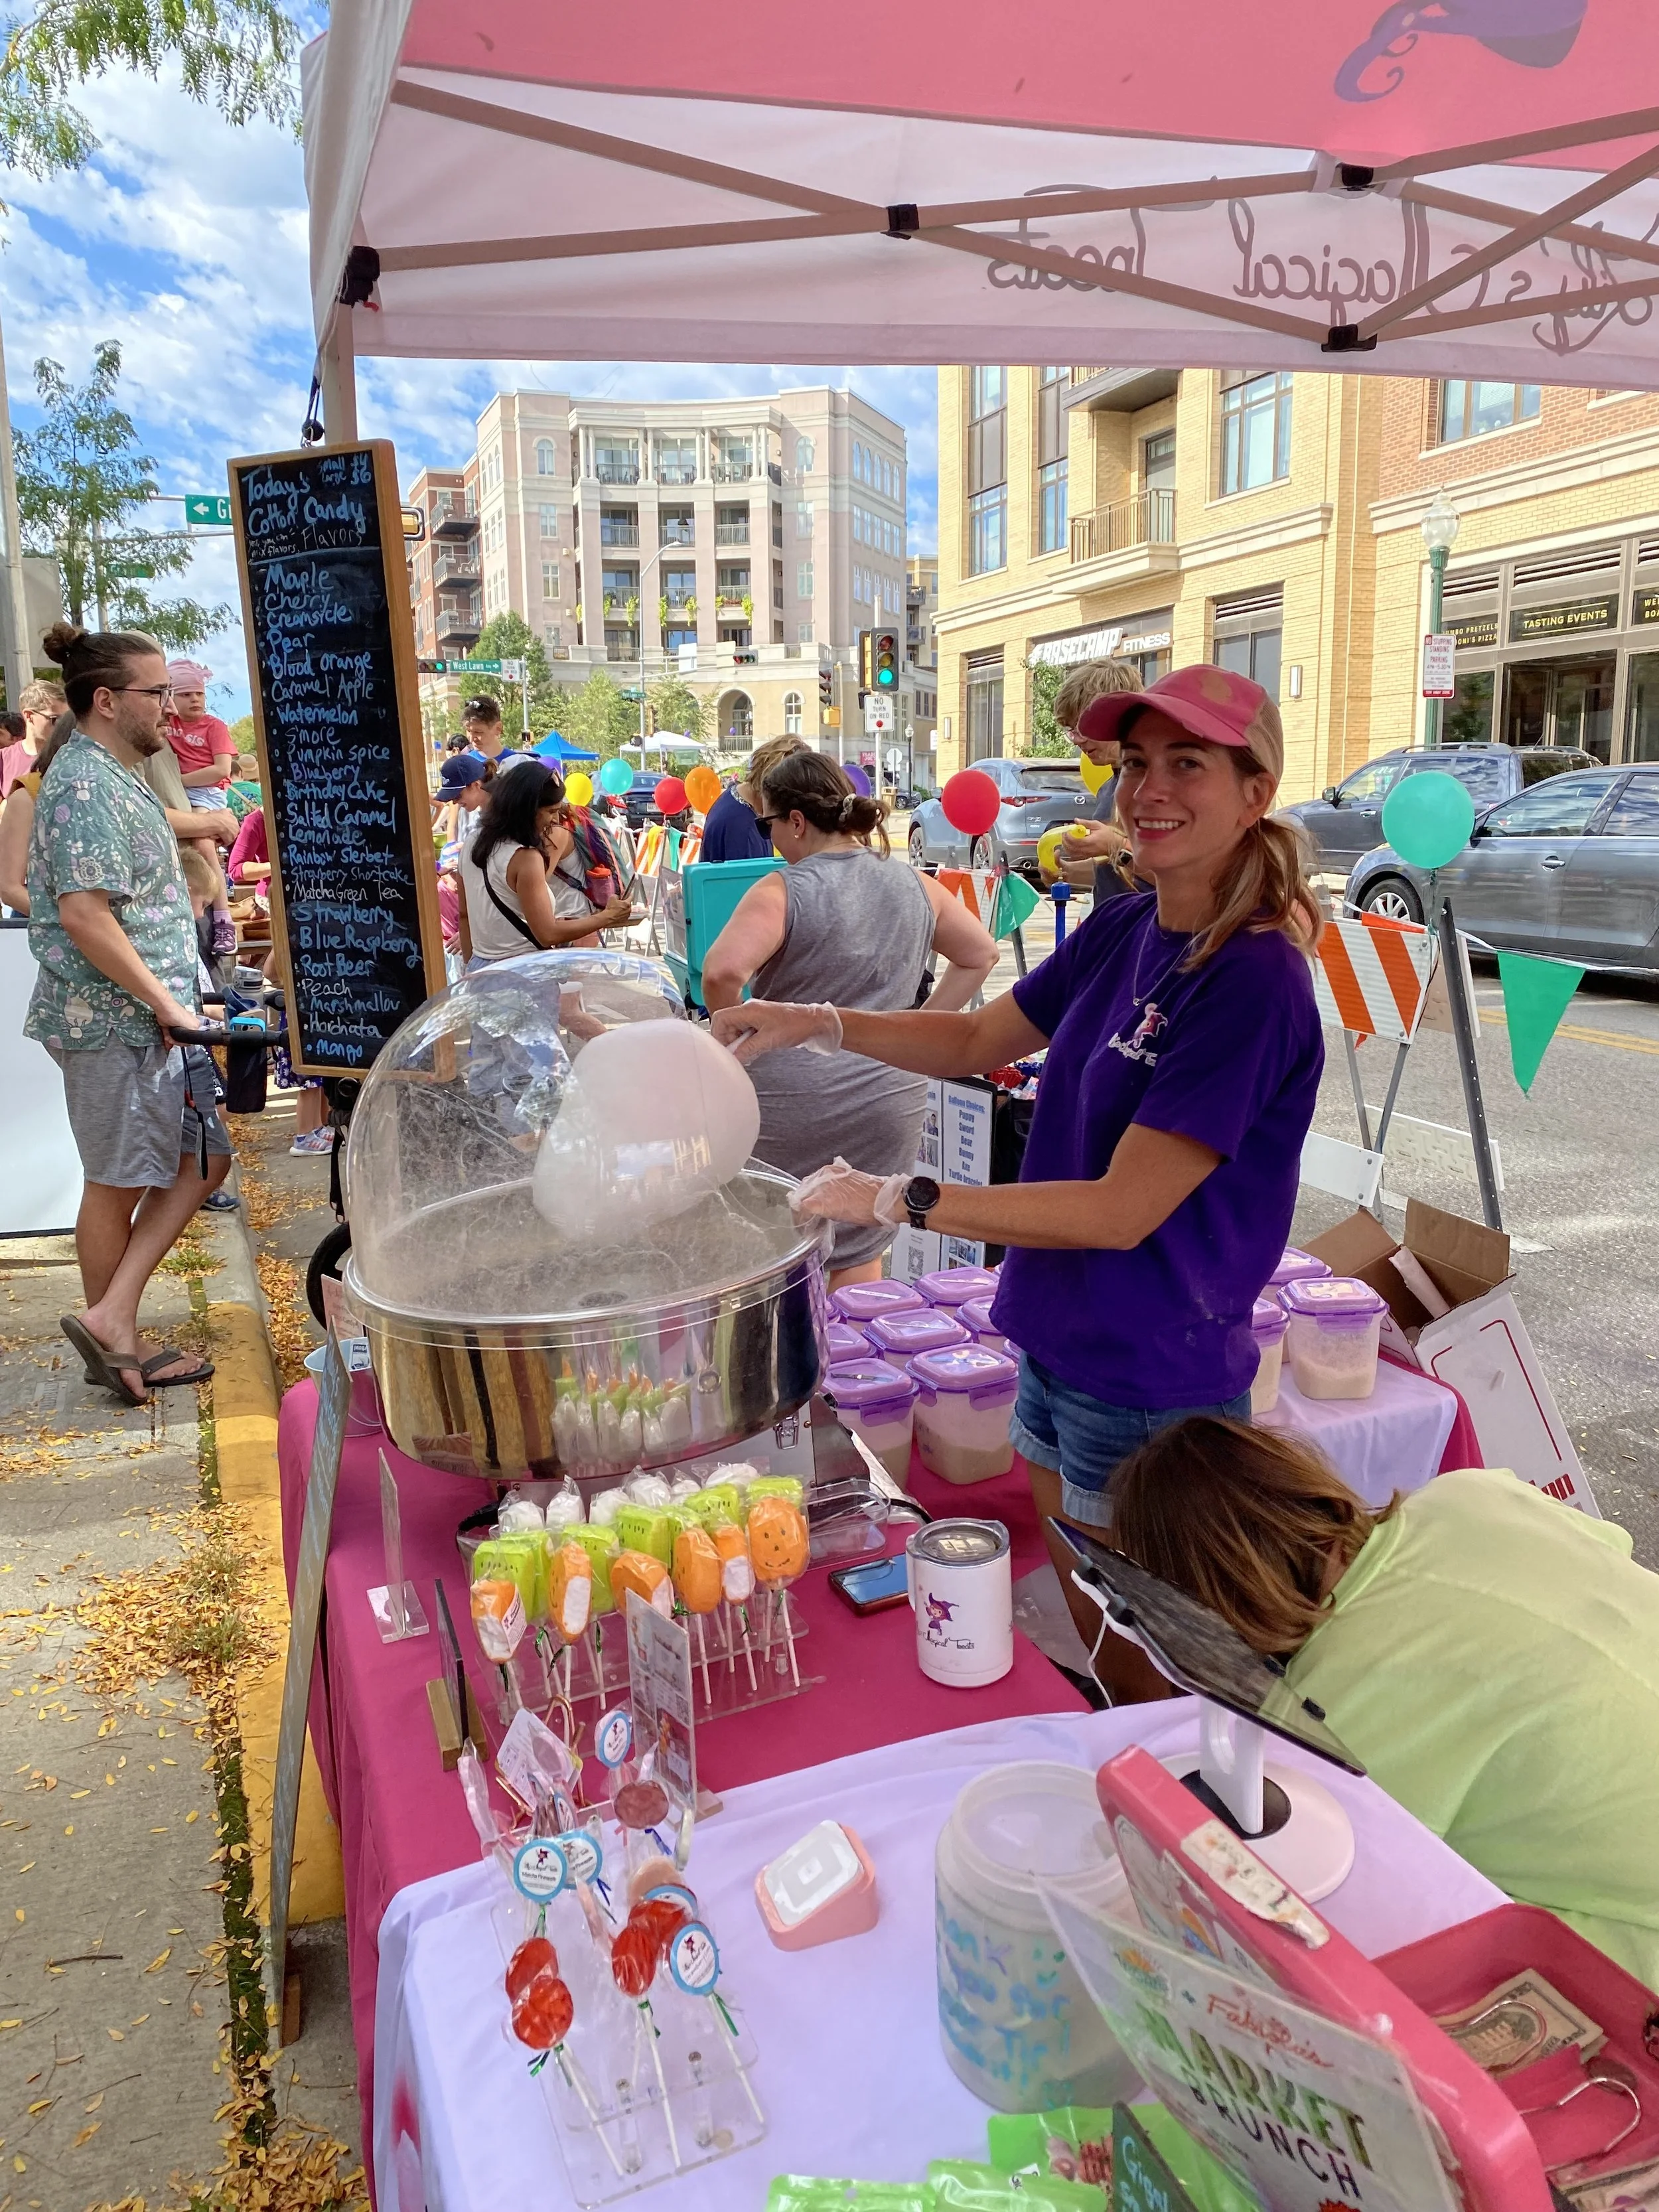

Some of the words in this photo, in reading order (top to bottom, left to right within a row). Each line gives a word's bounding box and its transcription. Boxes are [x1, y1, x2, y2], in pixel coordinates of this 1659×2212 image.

[241, 466, 311, 510] Today's
[248, 502, 296, 536] Cotton
[304, 493, 366, 534] Candy
[301, 524, 362, 550] Flavors
[265, 561, 333, 593] Maple
[1644, 598, 1659, 607] WE
[1466, 623, 1498, 633] PRETZELS
[1524, 613, 1564, 629] TASTING
[1567, 609, 1608, 624] EVENTS
[267, 628, 315, 655] Pear
[1123, 632, 1171, 653] FITNESS
[1478, 633, 1497, 642] PIZZA
[268, 649, 315, 679] Blood
[453, 661, 467, 670] West
[469, 662, 484, 670] Lawn
[271, 674, 330, 702] Caramel
[337, 672, 374, 706] Apple
[276, 701, 358, 725] Watermelon
[287, 743, 344, 766] Pumpkin
[291, 763, 360, 781] Blueberry
[285, 778, 345, 800] Birthday
[348, 780, 390, 803] Cake
[285, 800, 332, 829] Salted
[334, 797, 396, 834] Caramel
[289, 824, 366, 846] Lemonade
[287, 844, 336, 866] Rainbow
[293, 879, 336, 903] Matcha
[336, 884, 368, 903] Green
[373, 879, 403, 901] Tea
[295, 899, 407, 934] Strawberry
[299, 923, 346, 951] Blue
[300, 953, 334, 977] Root
[336, 953, 375, 977] Beer
[302, 978, 352, 999] Peach
[309, 1011, 383, 1038] Horchata
[317, 1039, 363, 1066] Mango
[948, 1095, 966, 1107] Balloon
[959, 1110, 974, 1123] Puppy
[959, 1122, 974, 1135] Sword
[960, 1135, 973, 1147] Bear
[959, 1147, 974, 1161] Bunny
[948, 1168, 963, 1182] Turtle
[962, 1161, 970, 1171] Axe
[1135, 1999, 1374, 2173] MARKET
